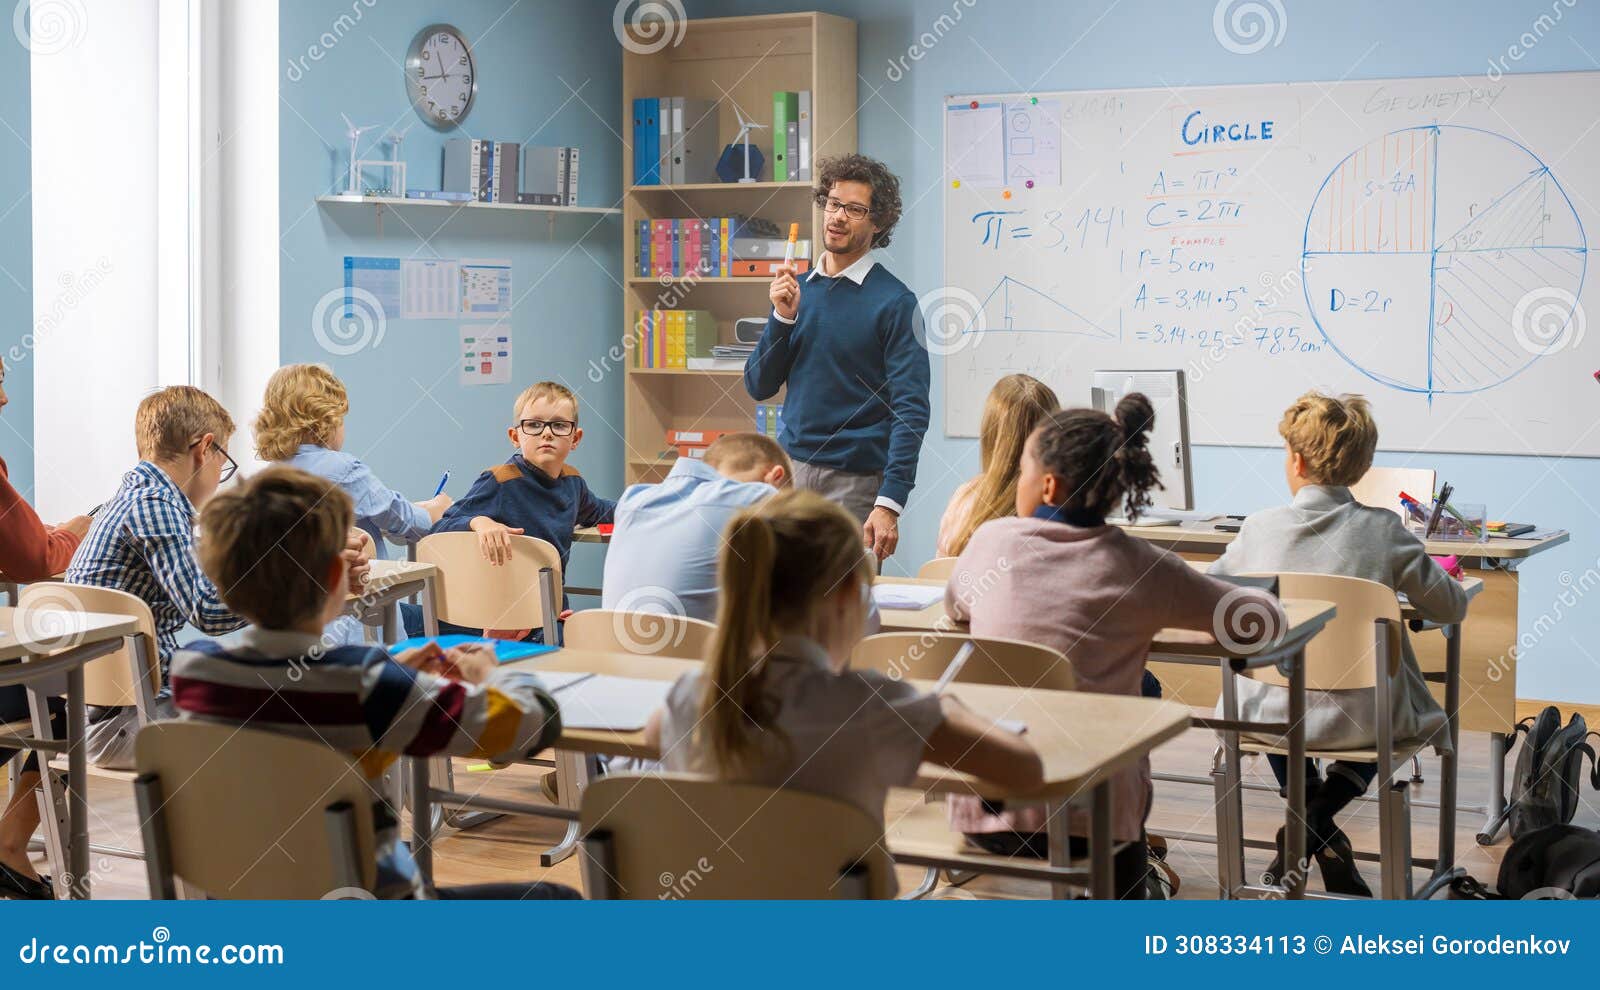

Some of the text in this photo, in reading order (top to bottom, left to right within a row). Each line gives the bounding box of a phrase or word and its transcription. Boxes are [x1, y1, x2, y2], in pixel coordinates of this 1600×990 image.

[438, 33, 449, 44] 12
[459, 55, 467, 66] 2
[462, 74, 470, 85] 3
[458, 92, 466, 102] 4
[427, 100, 435, 112] 7
[439, 109, 447, 120] 6
